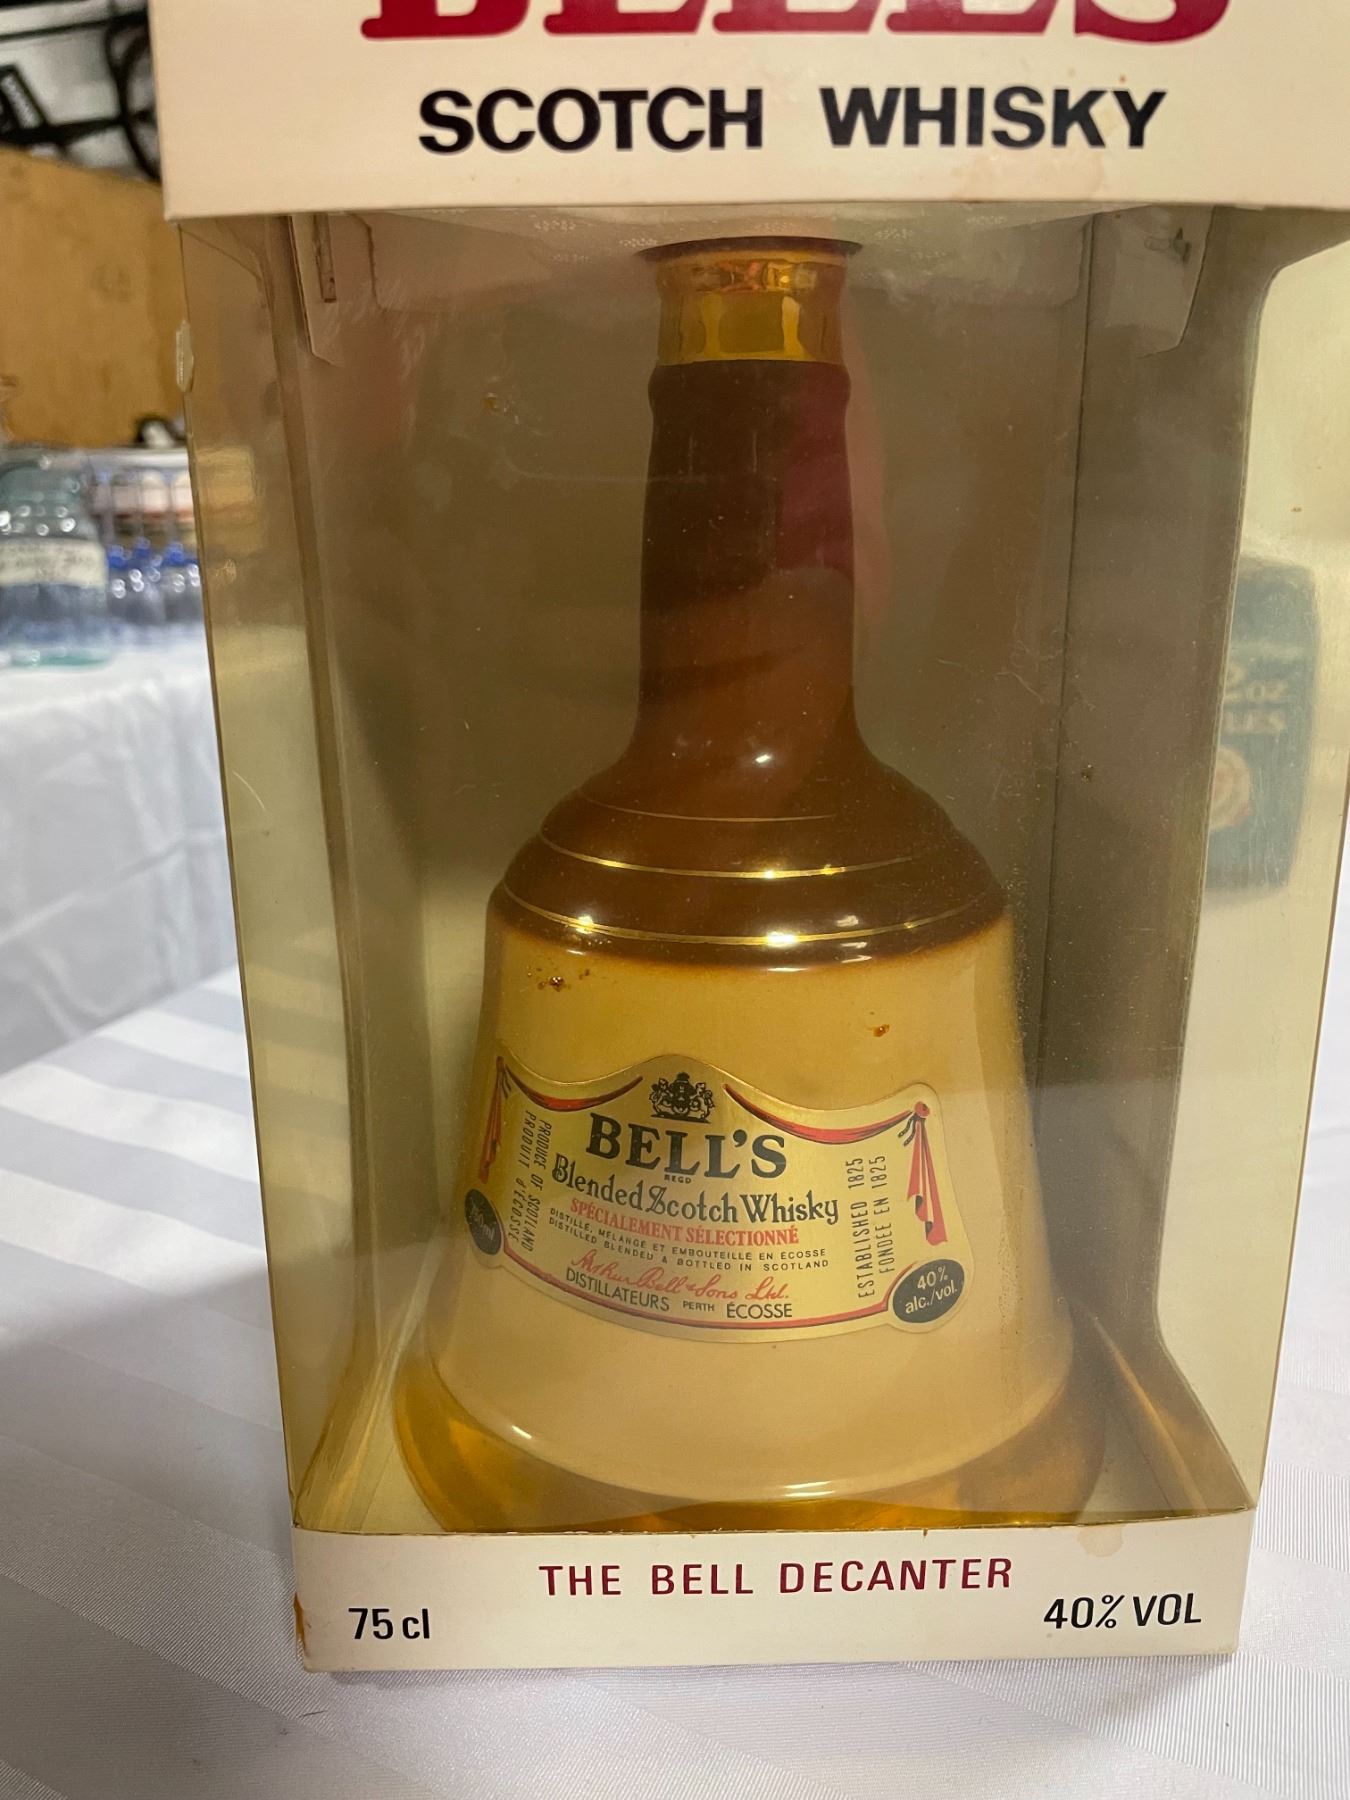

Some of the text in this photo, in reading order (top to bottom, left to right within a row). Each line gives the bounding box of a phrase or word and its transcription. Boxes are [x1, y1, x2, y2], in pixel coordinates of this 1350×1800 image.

[417, 86, 1168, 153] SCOTCH WHISKY
[518, 1110, 537, 1169] PRODUIT
[585, 1112, 787, 1178] BELL'S
[521, 1119, 552, 1252] PRODUCE OF SCOTLAND
[552, 1153, 839, 1225] Blended Scotch Whisky
[868, 1155, 888, 1189] 1825
[570, 1198, 799, 1246] SPÉCIALEMENT SÉLECTIONNÉ
[845, 1158, 876, 1298] ESTABLISHED 1825
[873, 1197, 891, 1215] EN
[549, 1217, 597, 1244] DISTILLED
[603, 1241, 654, 1260] BLENDED
[677, 1257, 731, 1270] BOTTLED
[740, 1263, 752, 1272] IN
[763, 1259, 829, 1272] SCOTLAND
[759, 1252, 773, 1261] EN
[566, 1267, 793, 1319] DISTILLATEURS PERTH ÉCOSSE
[904, 1280, 958, 1314] alc./vol.
[917, 1266, 948, 1290] 40%
[539, 1558, 1013, 1596] THE BELL DECANTER
[348, 1607, 431, 1640] 75 cl
[1044, 1592, 1202, 1630] 40% VOL
